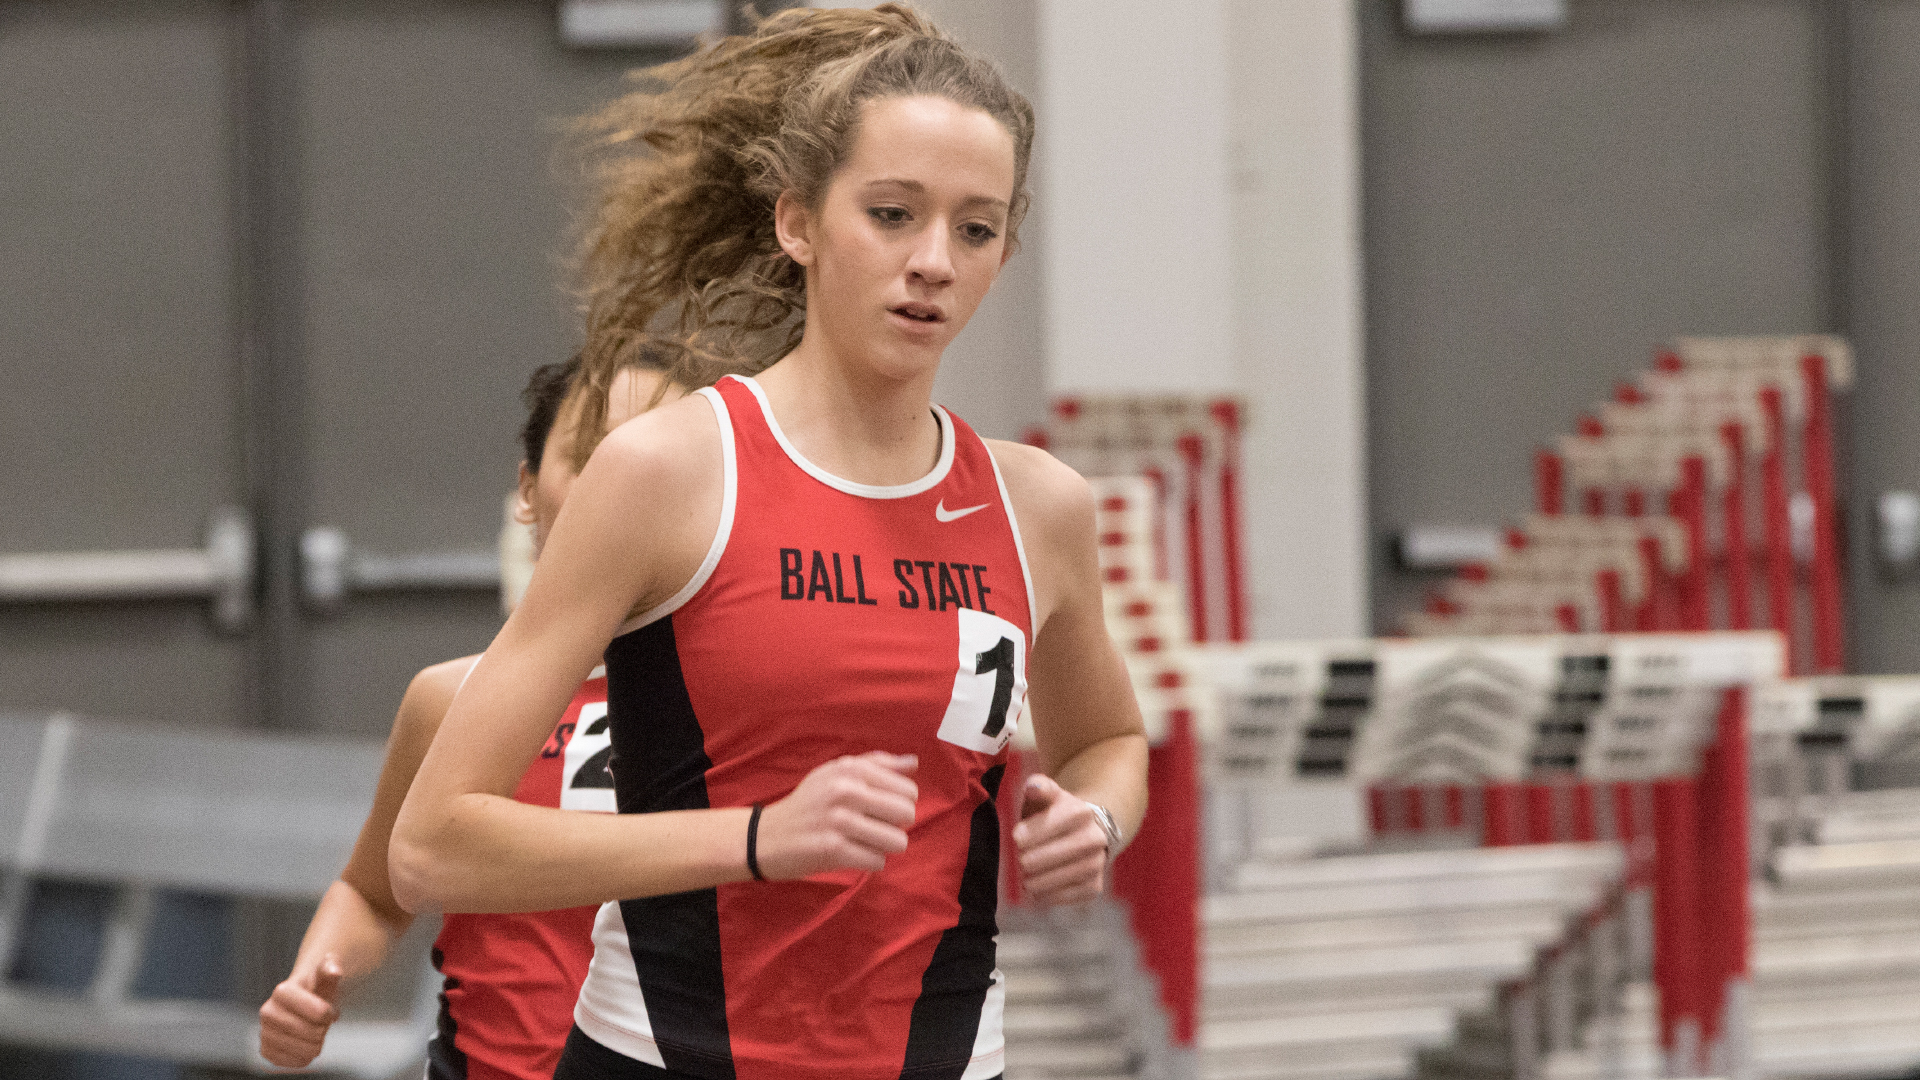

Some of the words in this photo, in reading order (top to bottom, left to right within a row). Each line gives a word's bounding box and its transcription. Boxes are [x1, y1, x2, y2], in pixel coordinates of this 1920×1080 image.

[780, 548, 878, 606] BALL
[893, 558, 996, 616] STATE
[975, 635, 1015, 739] 1
[569, 714, 616, 790] 2
